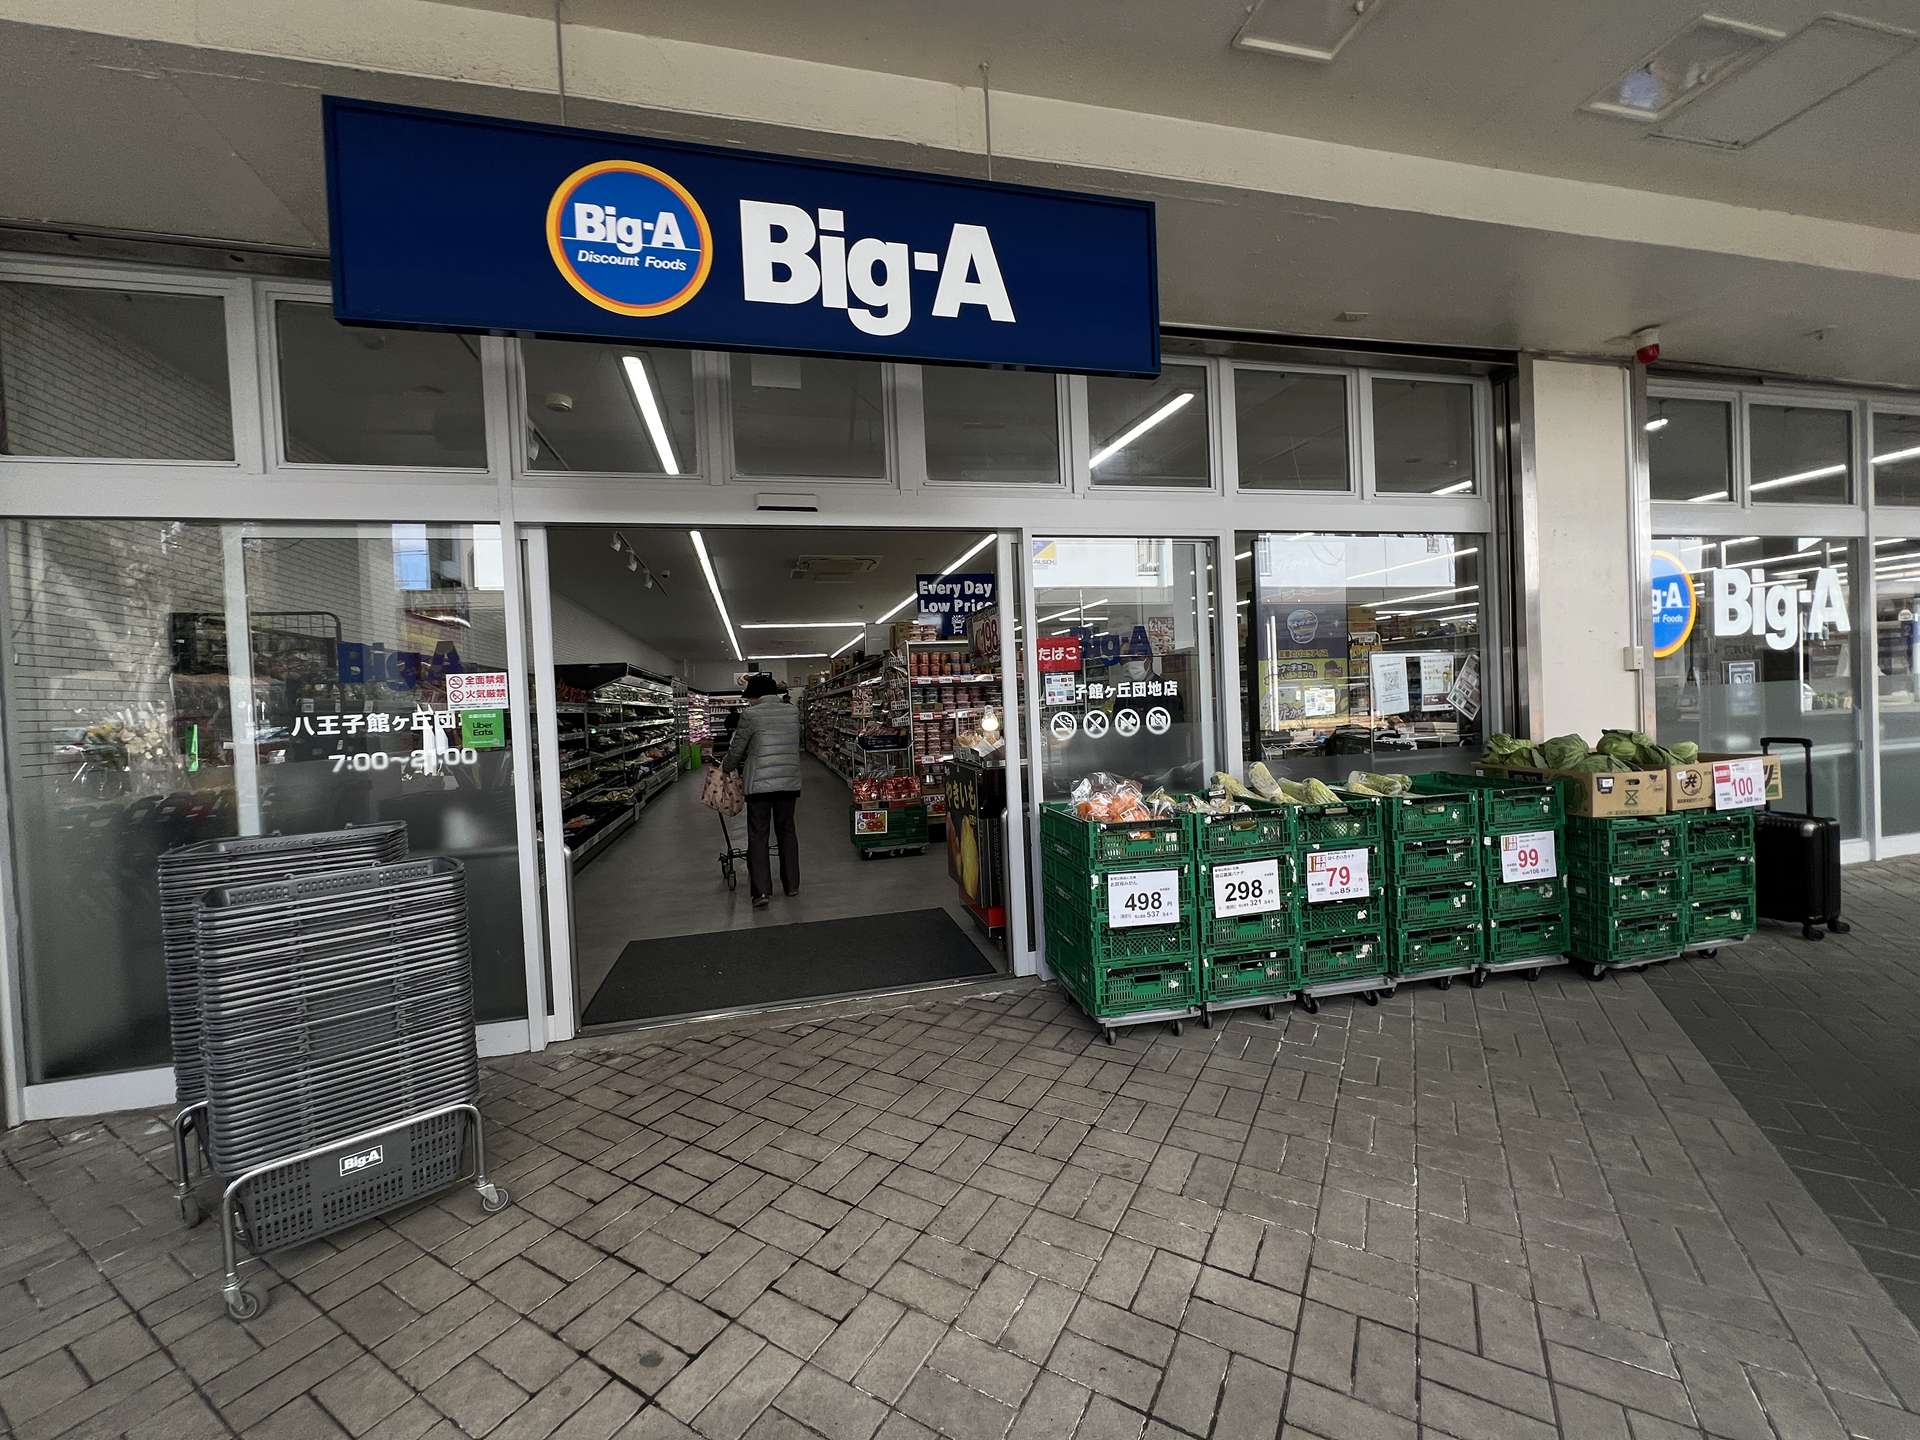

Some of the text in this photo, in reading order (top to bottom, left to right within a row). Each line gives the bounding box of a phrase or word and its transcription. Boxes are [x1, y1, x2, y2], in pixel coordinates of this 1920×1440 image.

[574, 202, 686, 254] Big-A
[577, 250, 687, 271] Discount Foods
[739, 199, 1017, 336] Big-A
[919, 581, 993, 598] Every Day
[920, 600, 950, 612] Low
[1713, 568, 1851, 650] Big-A
[1662, 614, 1684, 623] Foods
[1038, 647, 1077, 661] たばこ
[465, 675, 505, 685] 全面禁煙
[465, 689, 506, 699] 火気厳禁
[1732, 777, 1753, 796] 100
[1518, 848, 1539, 868] 99
[1326, 866, 1351, 887] 79
[1125, 891, 1162, 911] 498
[1225, 880, 1263, 902] 298
[344, 1150, 380, 1170] Big-A
